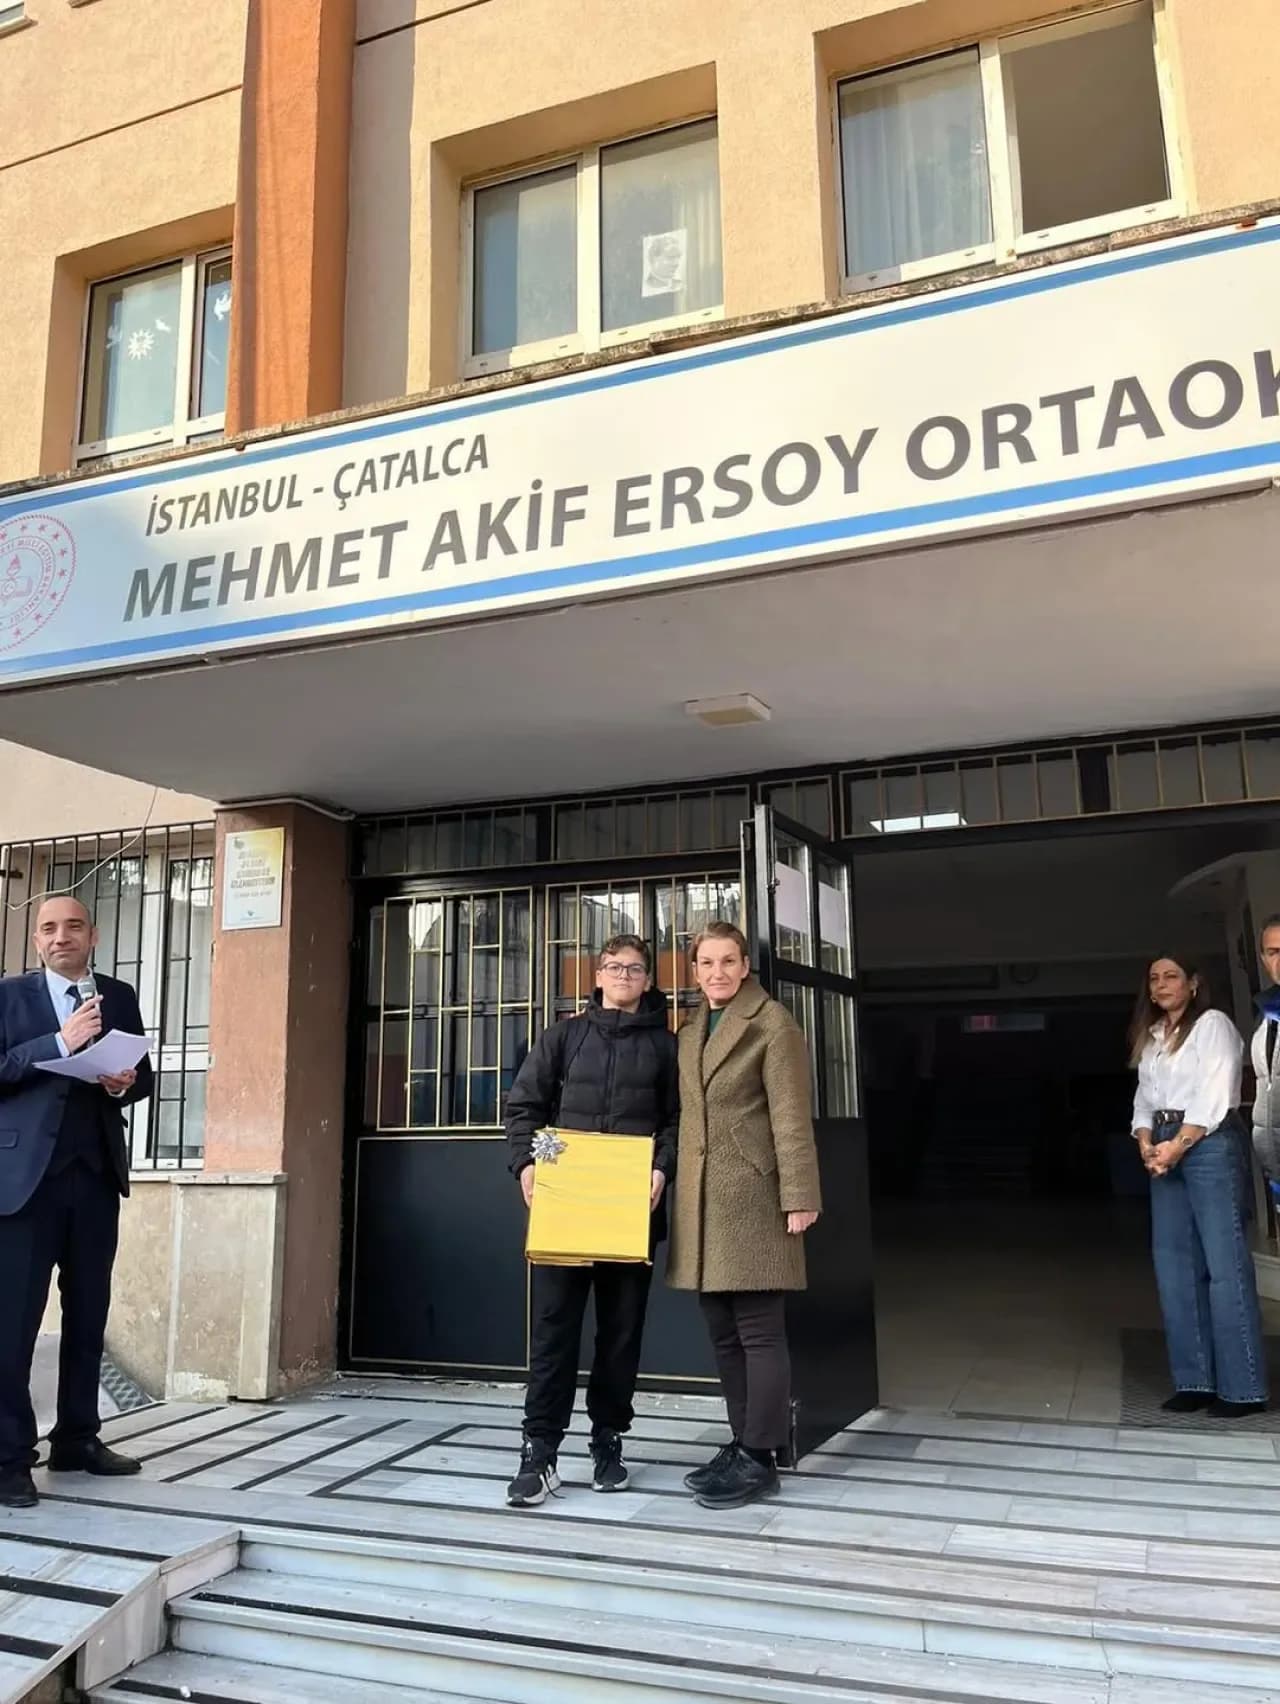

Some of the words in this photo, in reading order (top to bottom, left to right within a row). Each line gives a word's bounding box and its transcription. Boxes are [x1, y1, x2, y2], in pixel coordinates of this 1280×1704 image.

[123, 520, 408, 622] MEHMET
[421, 479, 588, 571] AKİF
[613, 428, 879, 538] ERSOY
[146, 473, 302, 537] İSTANBUL
[333, 434, 489, 510] ÇATALCA
